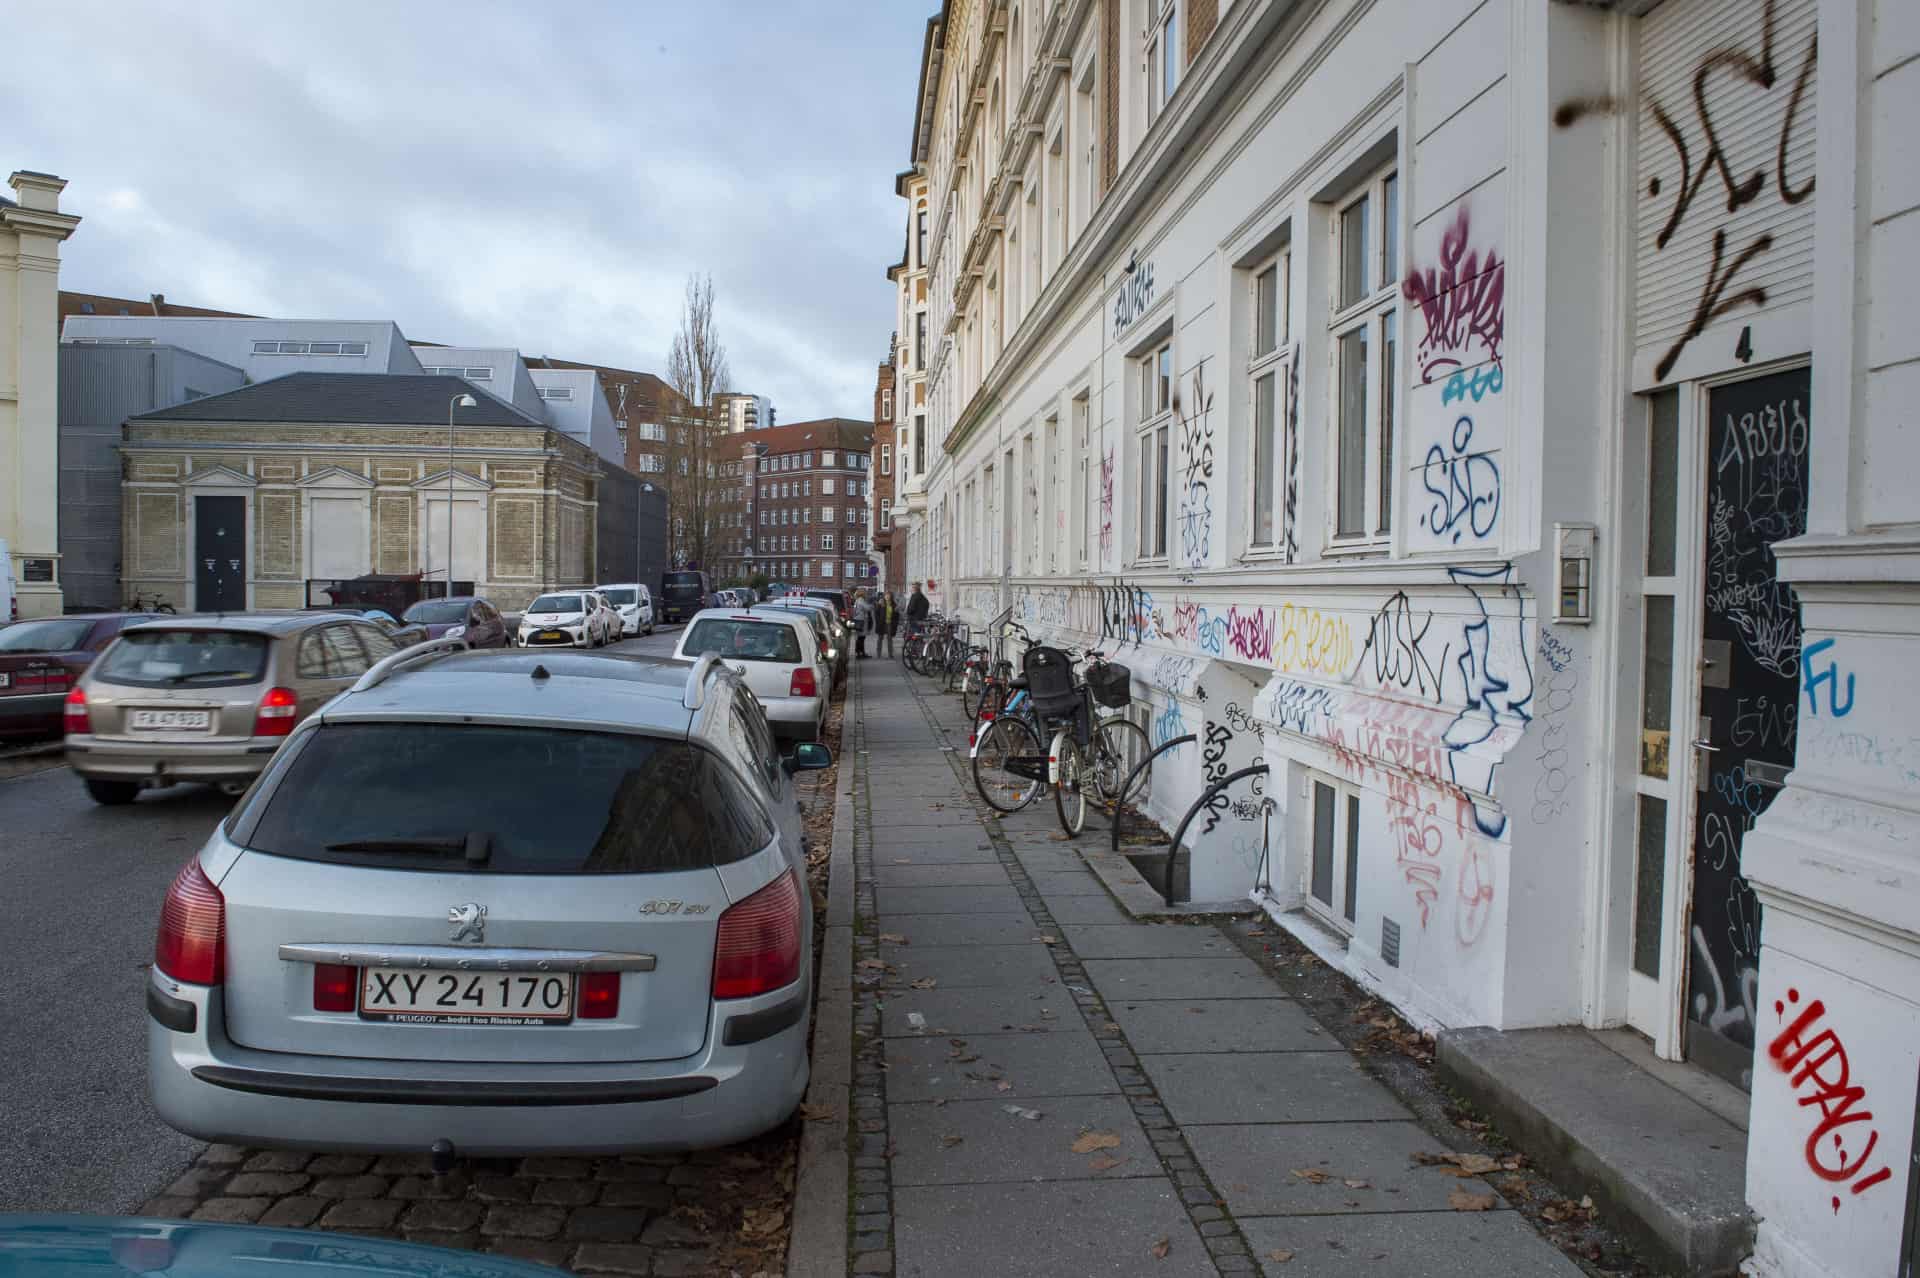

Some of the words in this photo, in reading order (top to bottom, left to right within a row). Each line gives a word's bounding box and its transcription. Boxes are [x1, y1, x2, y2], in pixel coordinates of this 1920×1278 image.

[1735, 326, 1753, 363] 4
[1802, 637, 1856, 718] FU
[639, 899, 684, 915] 407
[372, 973, 427, 1005] XY
[436, 974, 484, 1007] 24
[498, 976, 565, 1009] 170
[396, 1014, 437, 1023] PEUGEOT
[524, 1016, 545, 1025] Auto
